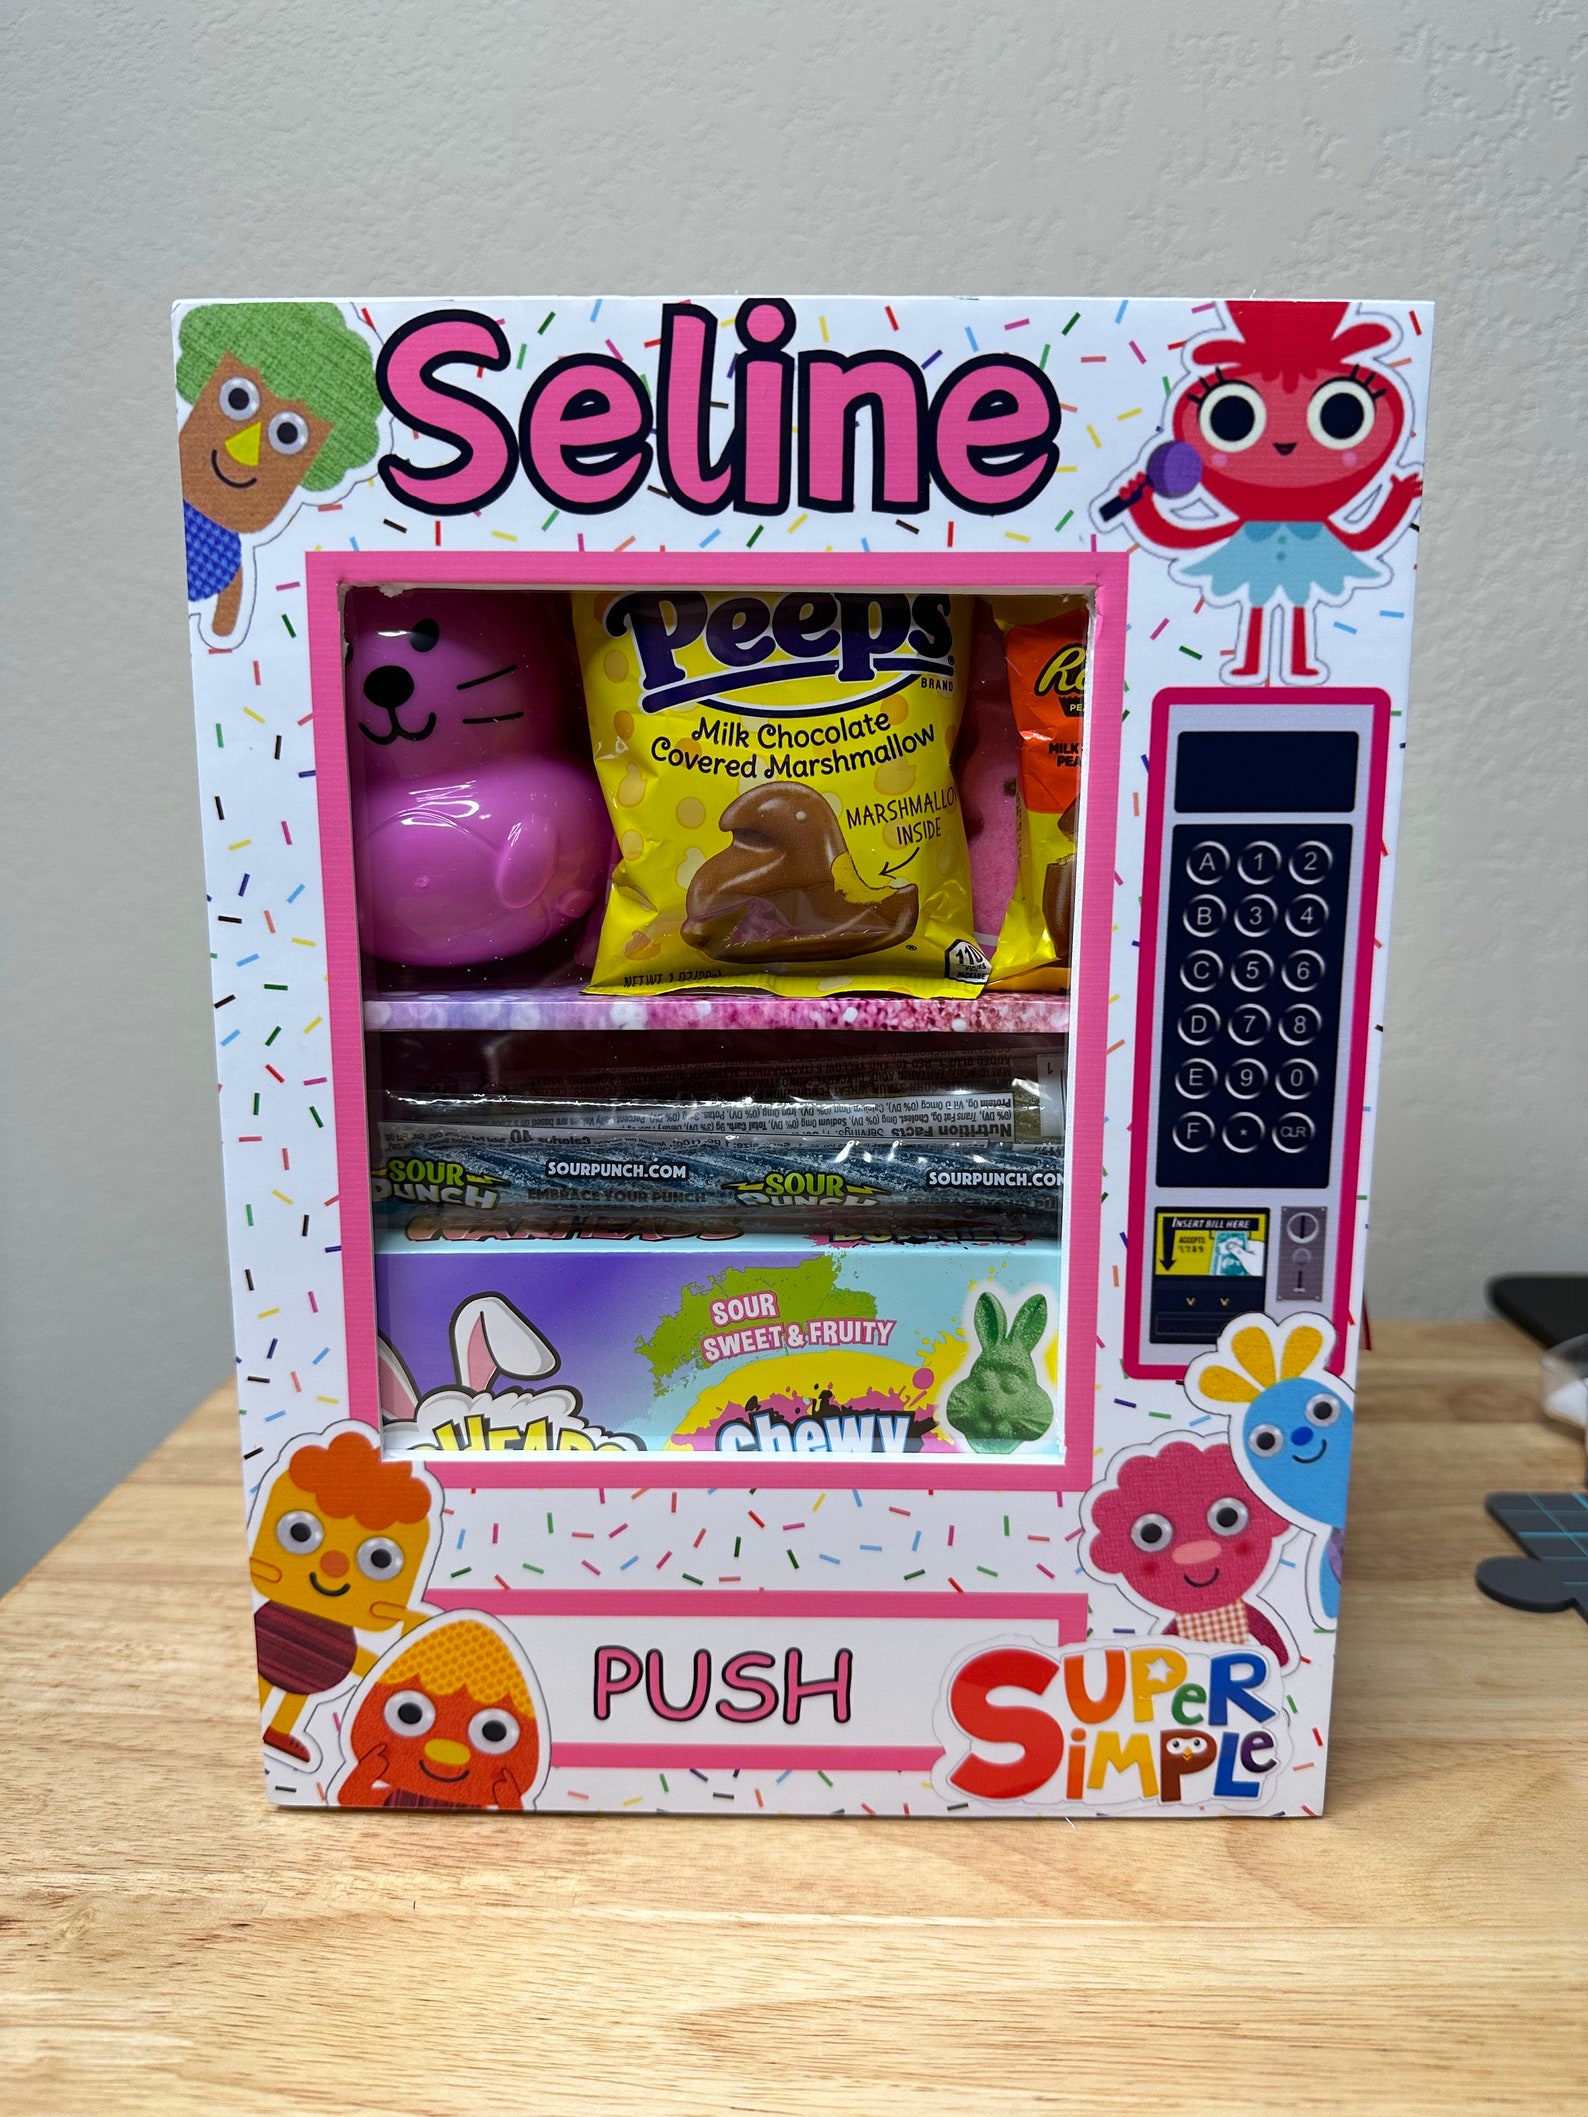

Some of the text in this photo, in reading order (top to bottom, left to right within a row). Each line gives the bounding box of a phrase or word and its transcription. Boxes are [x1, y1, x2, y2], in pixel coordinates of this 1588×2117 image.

[377, 298, 1062, 516] Seline
[603, 591, 953, 684] Peeps
[921, 677, 955, 692] BRAND
[692, 713, 891, 750] Milk Chocolate
[651, 724, 935, 778] Covered Marshmallow
[1048, 743, 1079, 754] MILK
[846, 787, 958, 829] MARSHMALLO
[896, 817, 942, 846] INSIDE
[1200, 852, 1317, 871] A 1 2
[1197, 906, 1314, 925] B 3 4
[1194, 961, 1309, 979] C 5 6
[1191, 1015, 1306, 1033] D 7 8
[1189, 1069, 1302, 1086] E 9 0
[903, 1101, 919, 1111] (0%
[921, 1100, 944, 1111] 0mcg
[965, 1099, 979, 1110] 0g,
[981, 1098, 1011, 1109] Protein
[665, 1112, 681, 1122] (0%
[701, 1111, 725, 1121] Potas.
[744, 1108, 761, 1119] (0%
[762, 1108, 780, 1118] 0mg
[781, 1108, 797, 1118] Iron
[930, 1112, 942, 1123] 0g,
[944, 1113, 956, 1122] Fat
[957, 1112, 977, 1122] Trans
[531, 1118, 554, 1128] based
[556, 1118, 568, 1126] are
[595, 1116, 615, 1125] aily
[617, 1115, 645, 1125] Percent
[785, 1119, 799, 1129] (0%
[801, 1118, 817, 1128] 0mg
[818, 1118, 847, 1128] Sodium
[866, 1115, 880, 1125] (0%
[882, 1114, 897, 1124] 0mg
[900, 1114, 929, 1125] Cholest.
[715, 1122, 725, 1132] 9g
[727, 1122, 747, 1131] Carb.
[749, 1121, 767, 1131] Total
[891, 1126, 933, 1137] Facts
[939, 1123, 1012, 1137] Nutrition
[1187, 1123, 1307, 1139] F CLR
[388, 1159, 465, 1187] SOUR
[548, 1162, 687, 1179] SOURPUNCH.COM
[764, 1172, 845, 1197] SOUR
[372, 1179, 498, 1209] PUNCH
[527, 1188, 600, 1200] EMBRACE
[603, 1190, 648, 1203] YOUR
[1172, 1217, 1250, 1229] INSERT BILL HERE
[710, 1291, 778, 1327] SOUR
[703, 1318, 898, 1363] SWEET & FRUITY
[594, 1645, 853, 1725] PUSH
